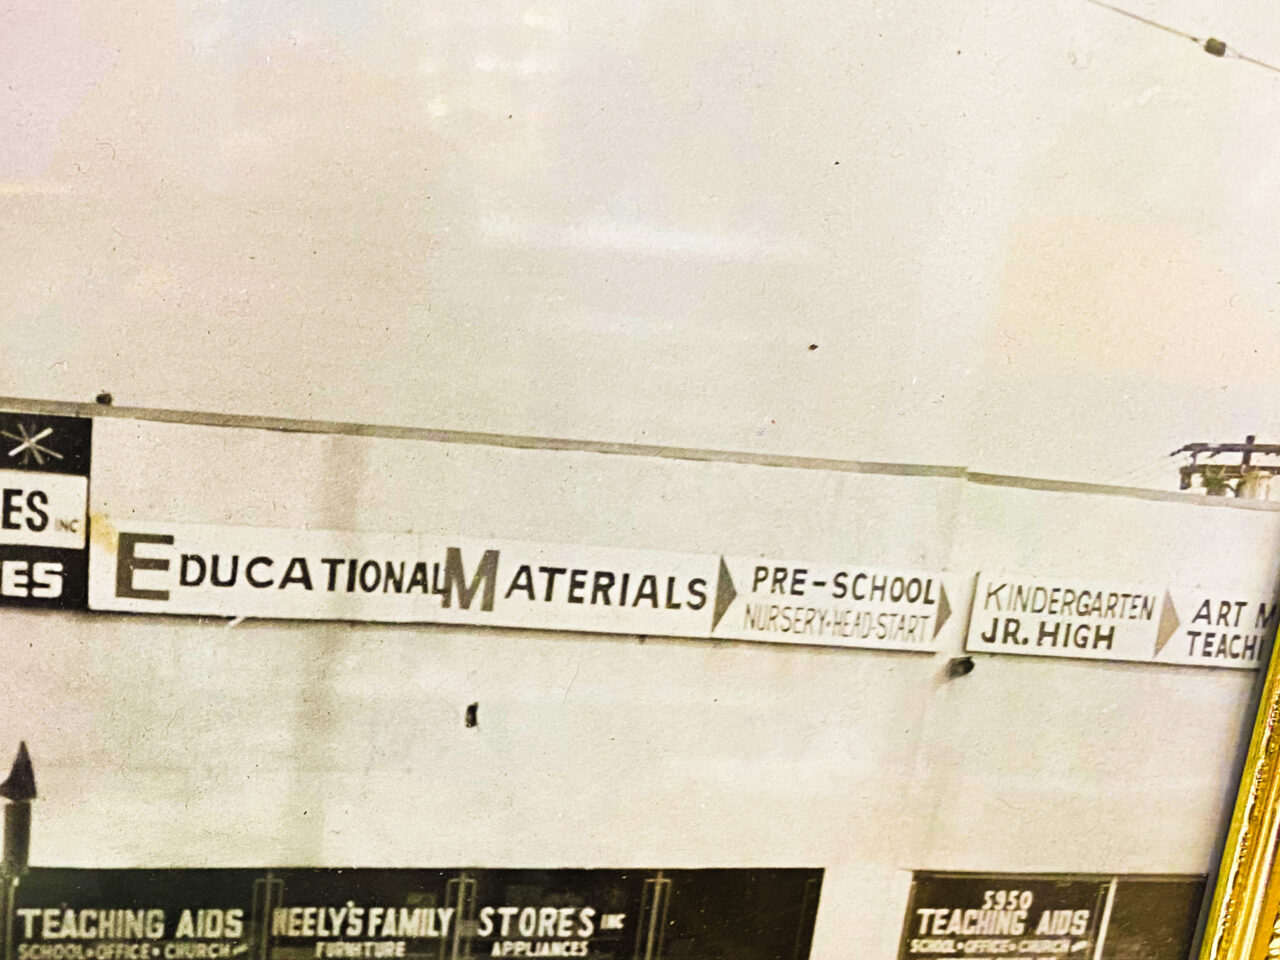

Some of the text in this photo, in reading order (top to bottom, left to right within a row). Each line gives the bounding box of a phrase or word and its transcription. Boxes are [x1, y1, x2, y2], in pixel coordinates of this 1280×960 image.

[115, 532, 708, 613] EDUCATIONAL MATERIALS
[982, 582, 1158, 622] KINDERGARTEN
[1191, 599, 1248, 627] ART
[980, 617, 1116, 651] JR. HIGH
[982, 890, 1034, 910] 5950
[17, 908, 245, 939] TEACHING AIDS
[272, 901, 364, 937] NEELY'S
[367, 907, 455, 937] FAMILY
[477, 907, 596, 938] STORES
[917, 908, 1090, 935] TEACHING AIDS
[491, 941, 589, 957] APPLIANCES
